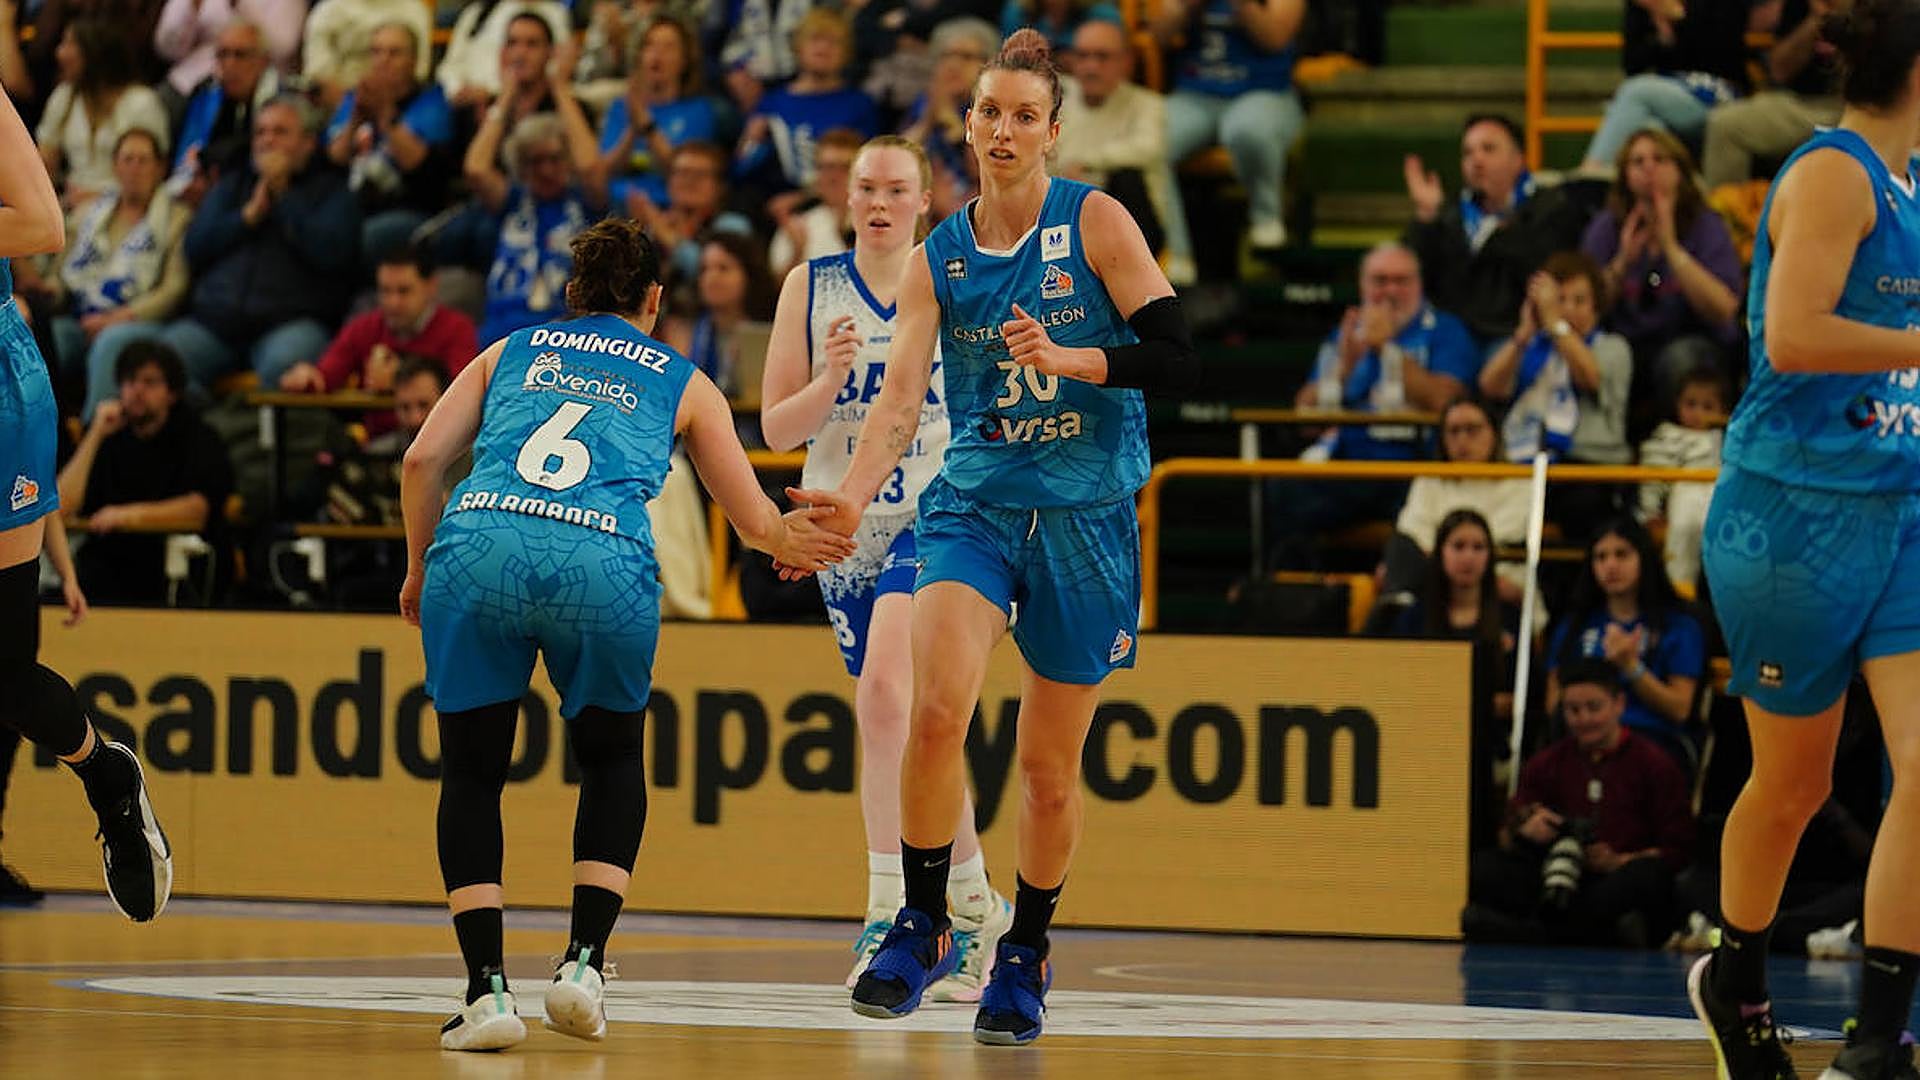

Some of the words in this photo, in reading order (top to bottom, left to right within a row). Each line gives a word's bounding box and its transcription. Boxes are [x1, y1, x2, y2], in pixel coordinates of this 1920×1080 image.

[953, 325, 1004, 343] CASTIL
[1041, 304, 1086, 328] LEÓN
[530, 329, 671, 374] DOMÍNGUEZ
[996, 359, 1059, 408] 30
[516, 401, 593, 491] 6
[872, 465, 904, 504] 3
